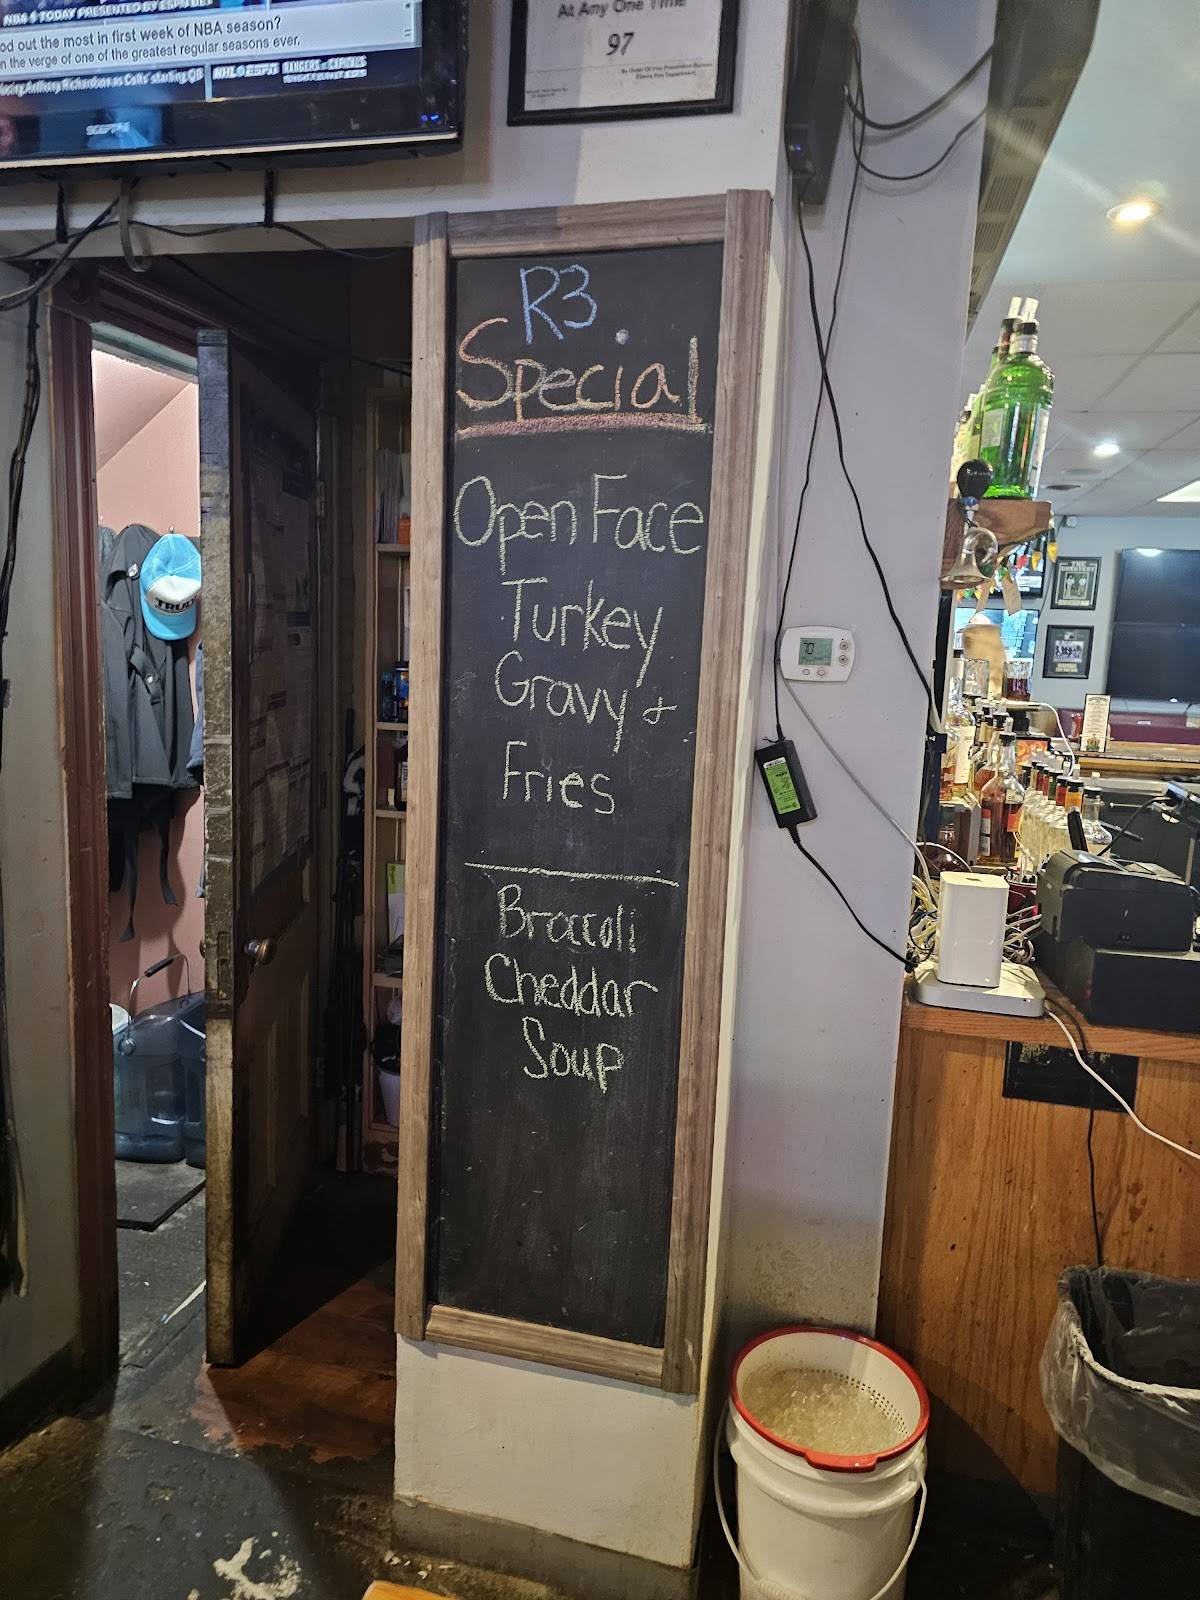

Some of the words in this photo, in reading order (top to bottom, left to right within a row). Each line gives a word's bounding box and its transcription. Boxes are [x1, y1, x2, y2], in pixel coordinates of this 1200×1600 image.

[18, 38, 37, 51] out
[40, 36, 60, 50] the
[63, 33, 94, 47] most
[98, 31, 109, 45] in
[112, 29, 136, 43] first
[140, 26, 174, 41] week
[177, 23, 191, 38] of
[194, 20, 222, 36] NBA
[226, 16, 281, 33] season?
[40, 8, 77, 22] TODAY
[77, 2, 140, 18] PRESENTED
[558, 4, 574, 18] At
[578, 2, 607, 18] Any
[613, 0, 642, 13] One
[606, 31, 635, 56] 97
[10, 57, 26, 69] the
[28, 56, 58, 69] verge
[61, 53, 71, 64] of
[75, 53, 95, 63] one
[98, 49, 108, 61] of
[112, 48, 128, 60] the
[131, 45, 176, 62] greatest
[180, 41, 219, 58] regular
[222, 39, 269, 52] seasons
[273, 34, 300, 47] ever.
[519, 263, 598, 345] R3
[456, 317, 703, 422] Special
[453, 475, 578, 575] Open
[591, 473, 705, 555] Face
[501, 576, 664, 688] Turkey
[495, 650, 628, 754] Gravy
[502, 740, 615, 814] Fries
[484, 952, 659, 1018] Cheddar
[521, 1016, 626, 1094] Soup
